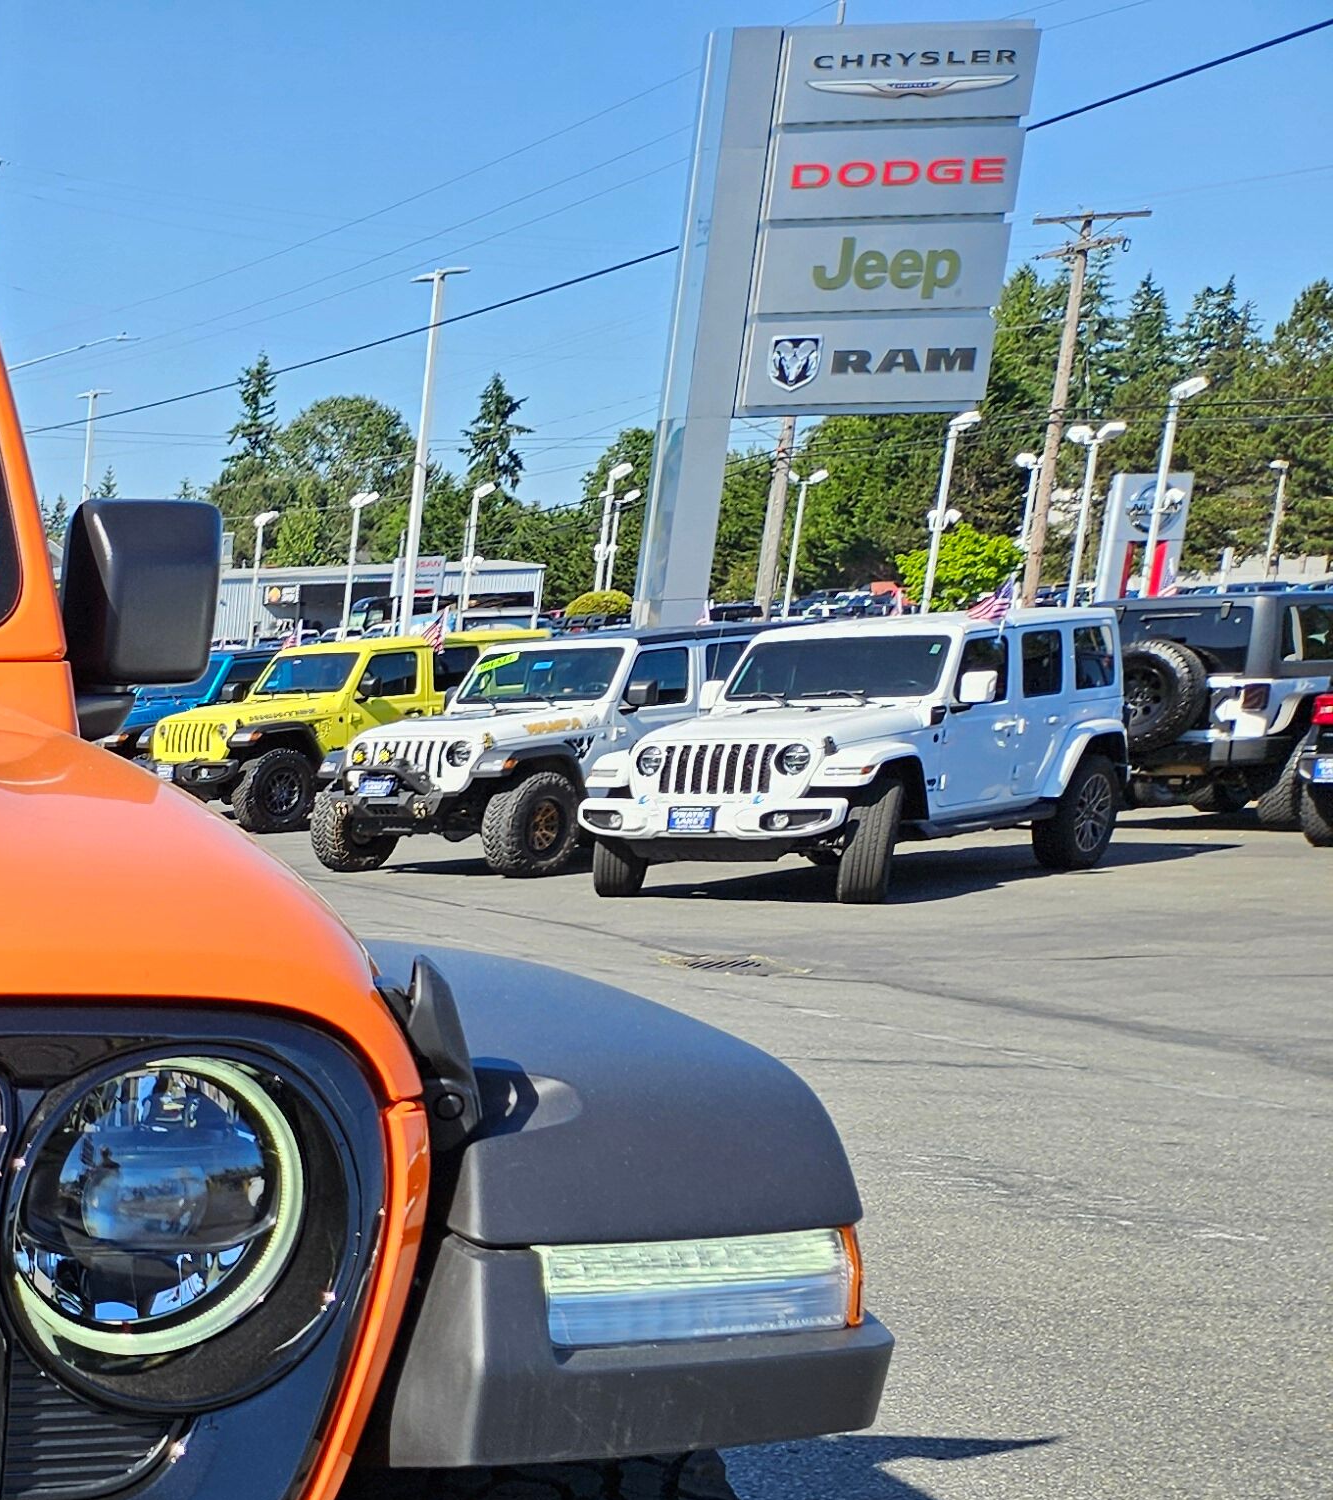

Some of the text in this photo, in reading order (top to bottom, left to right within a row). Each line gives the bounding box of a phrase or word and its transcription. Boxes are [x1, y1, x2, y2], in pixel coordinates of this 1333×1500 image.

[813, 48, 1018, 70] CHRYSLER
[790, 157, 1008, 190] DODGE
[812, 236, 961, 299] Jeep
[830, 346, 977, 376] RAM
